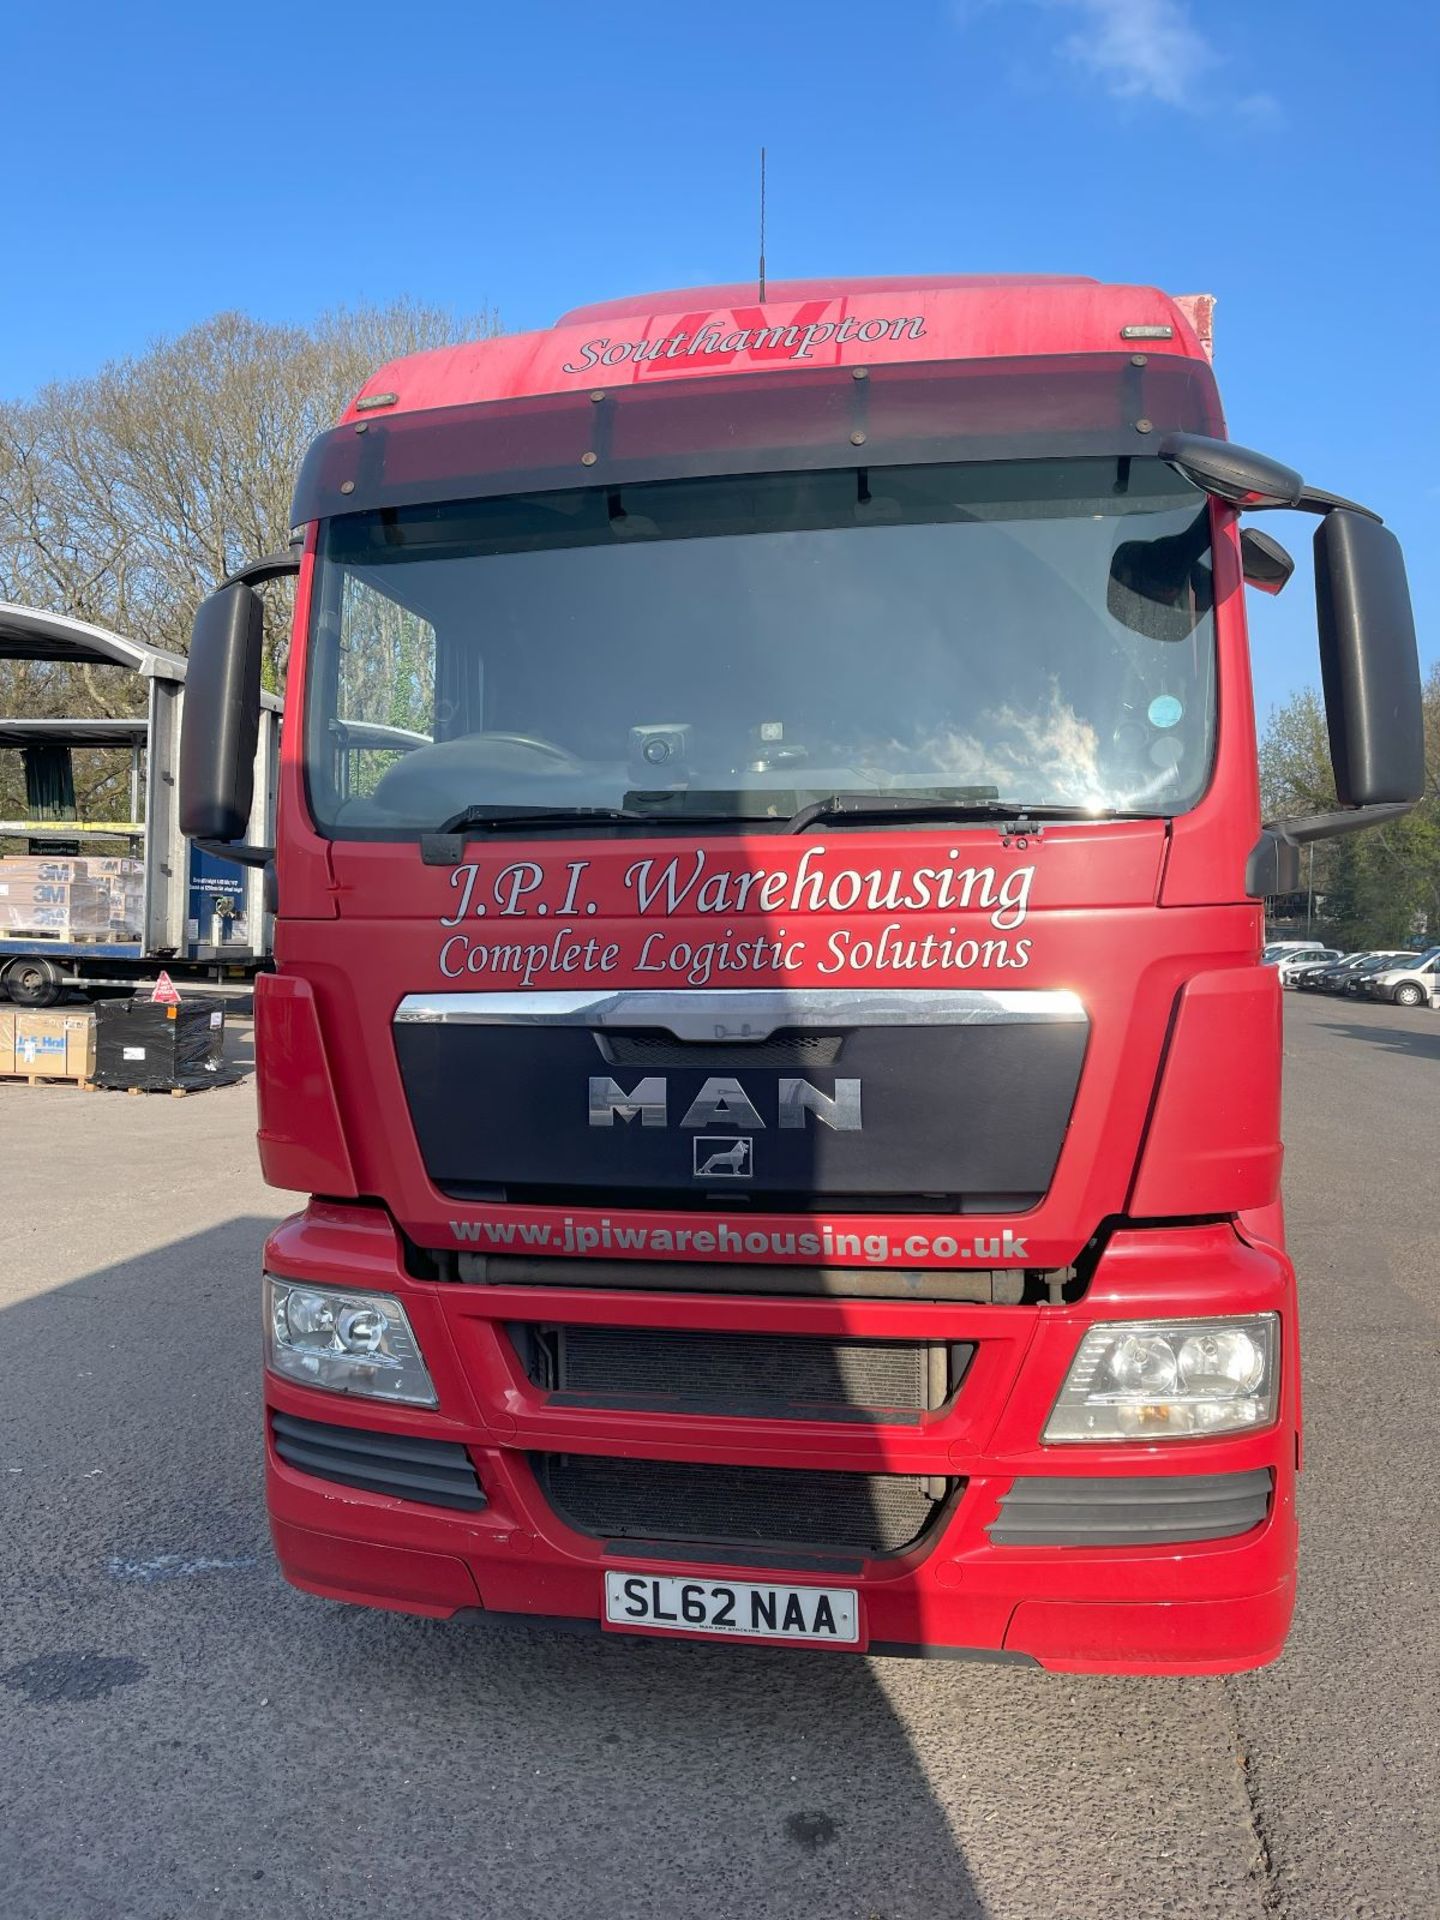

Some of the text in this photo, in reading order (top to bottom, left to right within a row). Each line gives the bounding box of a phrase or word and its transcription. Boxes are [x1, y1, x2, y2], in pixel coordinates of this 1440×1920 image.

[562, 315, 927, 374] Southampton
[33, 884, 65, 904] 3M
[439, 846, 1036, 930] J.P.I. Warehousing
[439, 922, 1033, 987] Complete Logistic Solutions
[588, 1076, 863, 1131] MAN
[449, 1217, 1029, 1263] www.jpiwarehousing.co.uk
[623, 1577, 838, 1635] SL62 NAA
